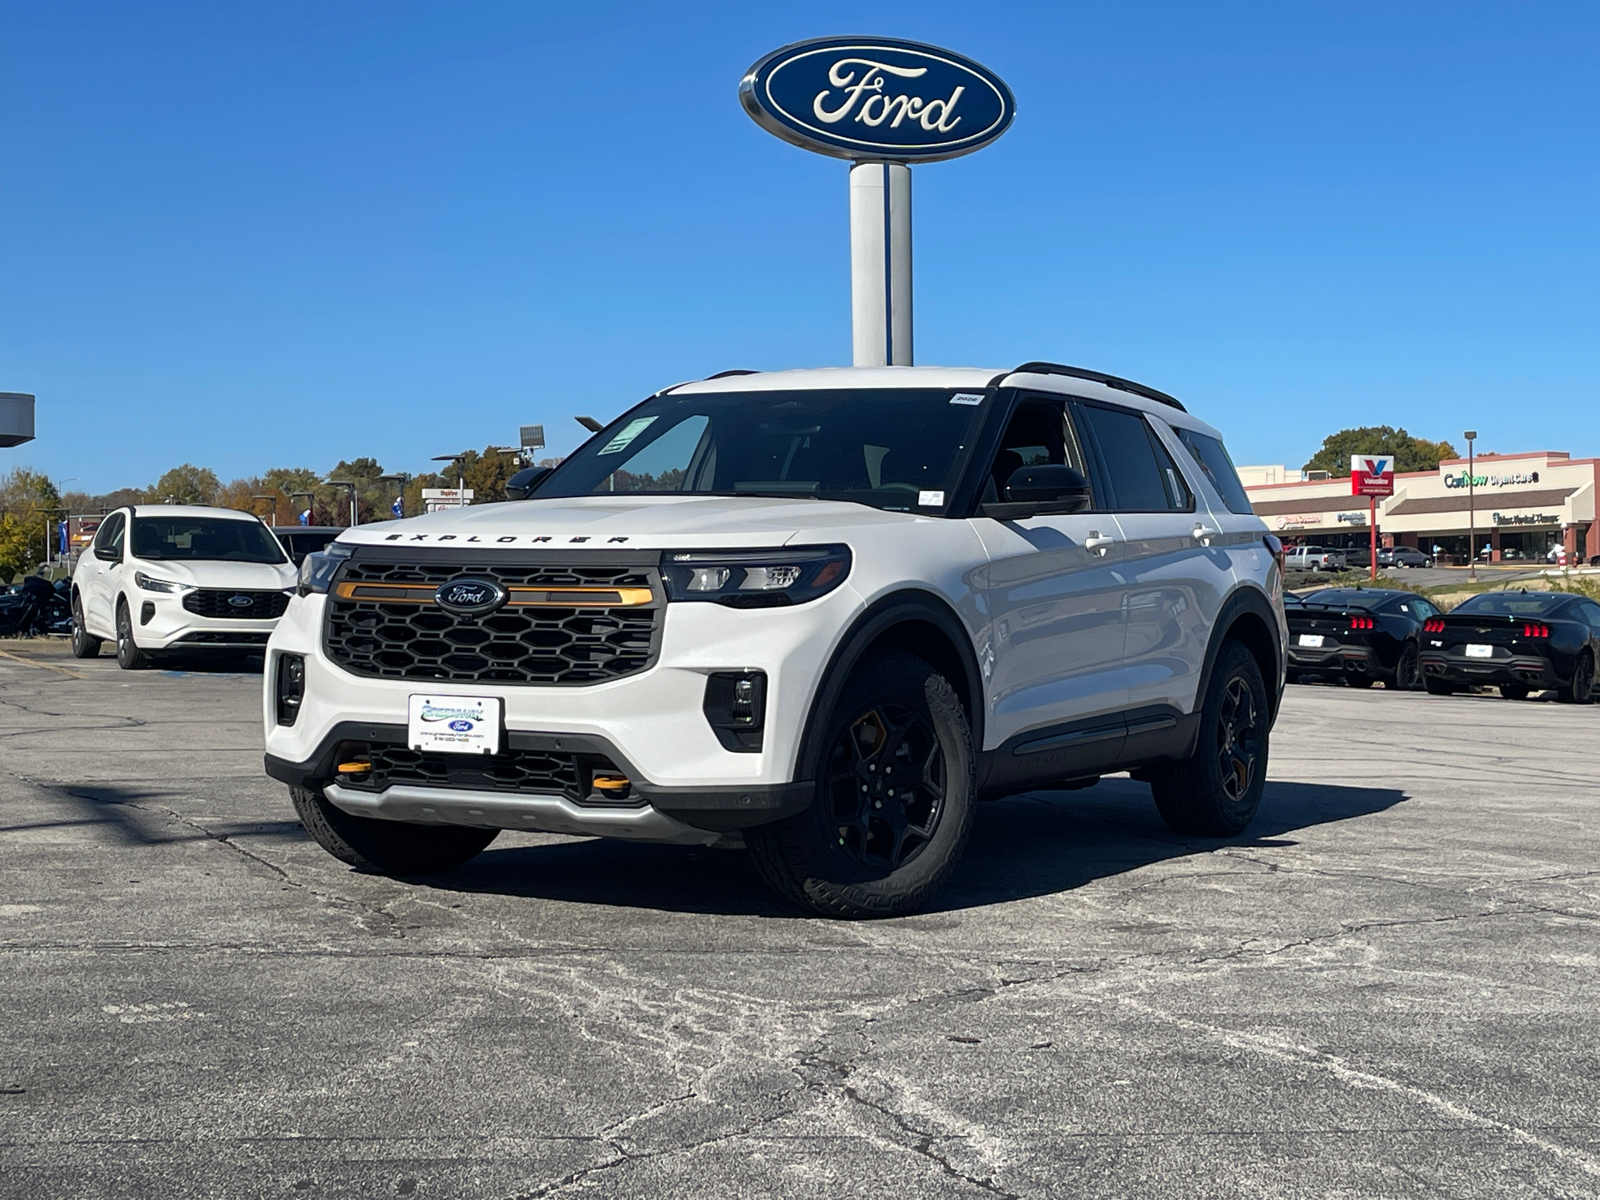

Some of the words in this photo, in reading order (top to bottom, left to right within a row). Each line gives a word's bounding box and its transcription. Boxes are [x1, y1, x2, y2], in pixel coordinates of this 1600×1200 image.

[813, 58, 966, 133] Ford
[384, 533, 630, 544] EXPLORER
[447, 585, 486, 603] Ford
[421, 705, 484, 719] GREENWAY
